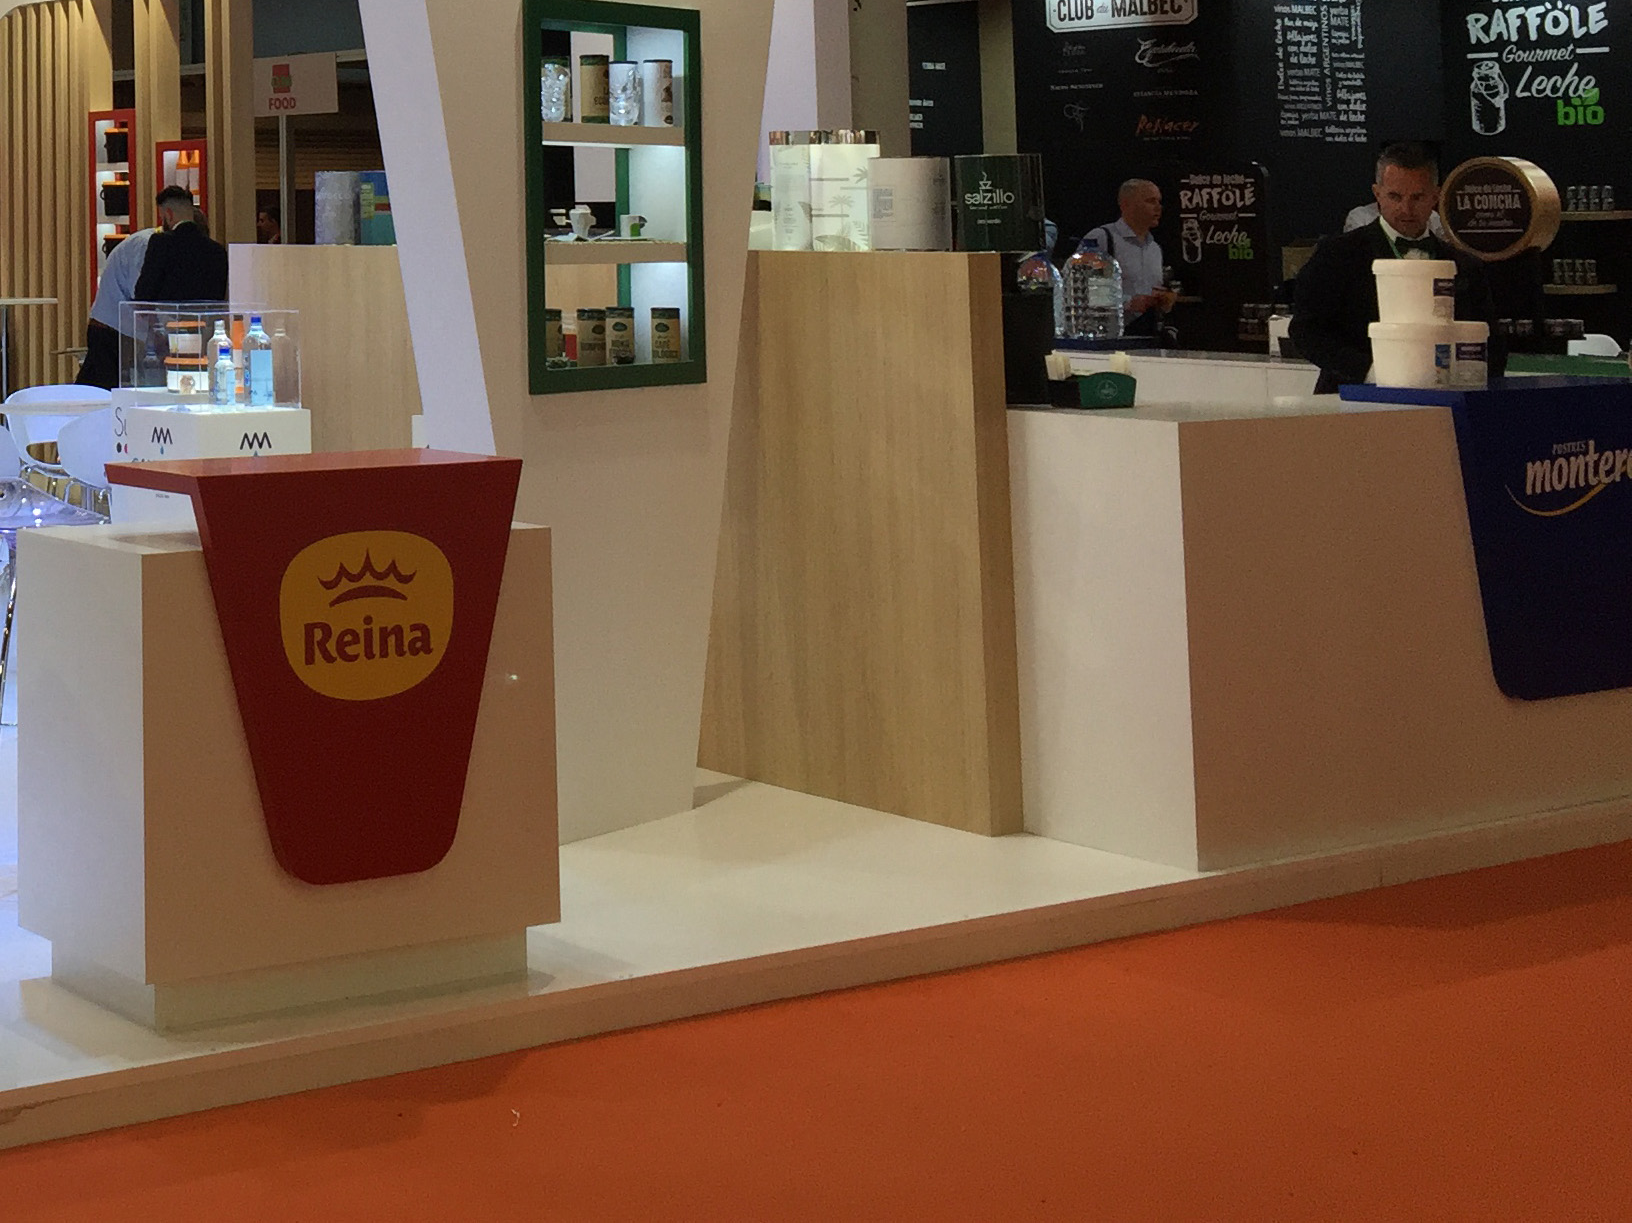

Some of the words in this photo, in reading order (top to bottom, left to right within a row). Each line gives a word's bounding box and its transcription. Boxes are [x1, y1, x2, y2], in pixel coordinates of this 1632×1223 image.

[1319, 5, 1331, 75] ARGENTINOS
[1503, 44, 1574, 63] Gourmet
[1515, 62, 1596, 98] Leche
[268, 97, 297, 110] FOOD
[964, 189, 1015, 204] salzillo
[1456, 195, 1471, 210] LA
[1474, 194, 1521, 210] CONCHA
[1206, 225, 1248, 244] Leche
[303, 615, 433, 666] Reina
